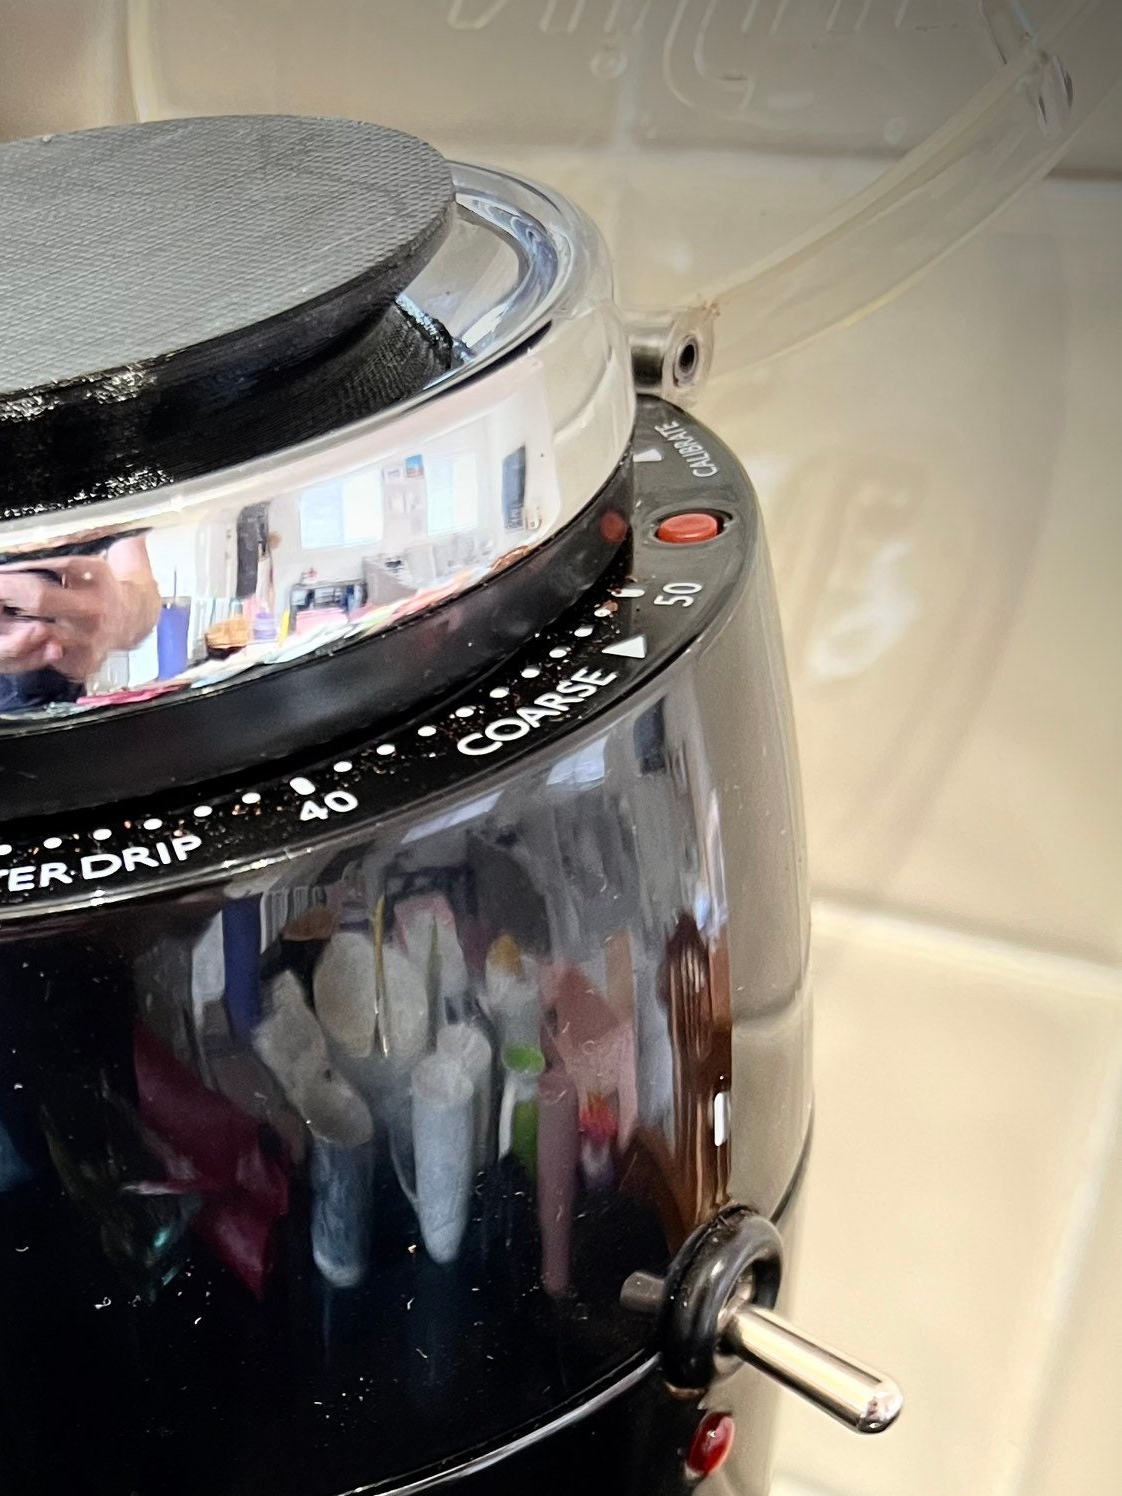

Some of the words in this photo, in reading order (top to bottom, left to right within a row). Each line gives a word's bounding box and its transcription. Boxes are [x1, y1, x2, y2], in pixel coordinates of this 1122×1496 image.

[654, 419, 719, 479] CALIBRATE
[654, 581, 703, 608] 50
[456, 667, 618, 756] COARSE
[299, 790, 359, 823] 40
[80, 834, 203, 881] DRIP
